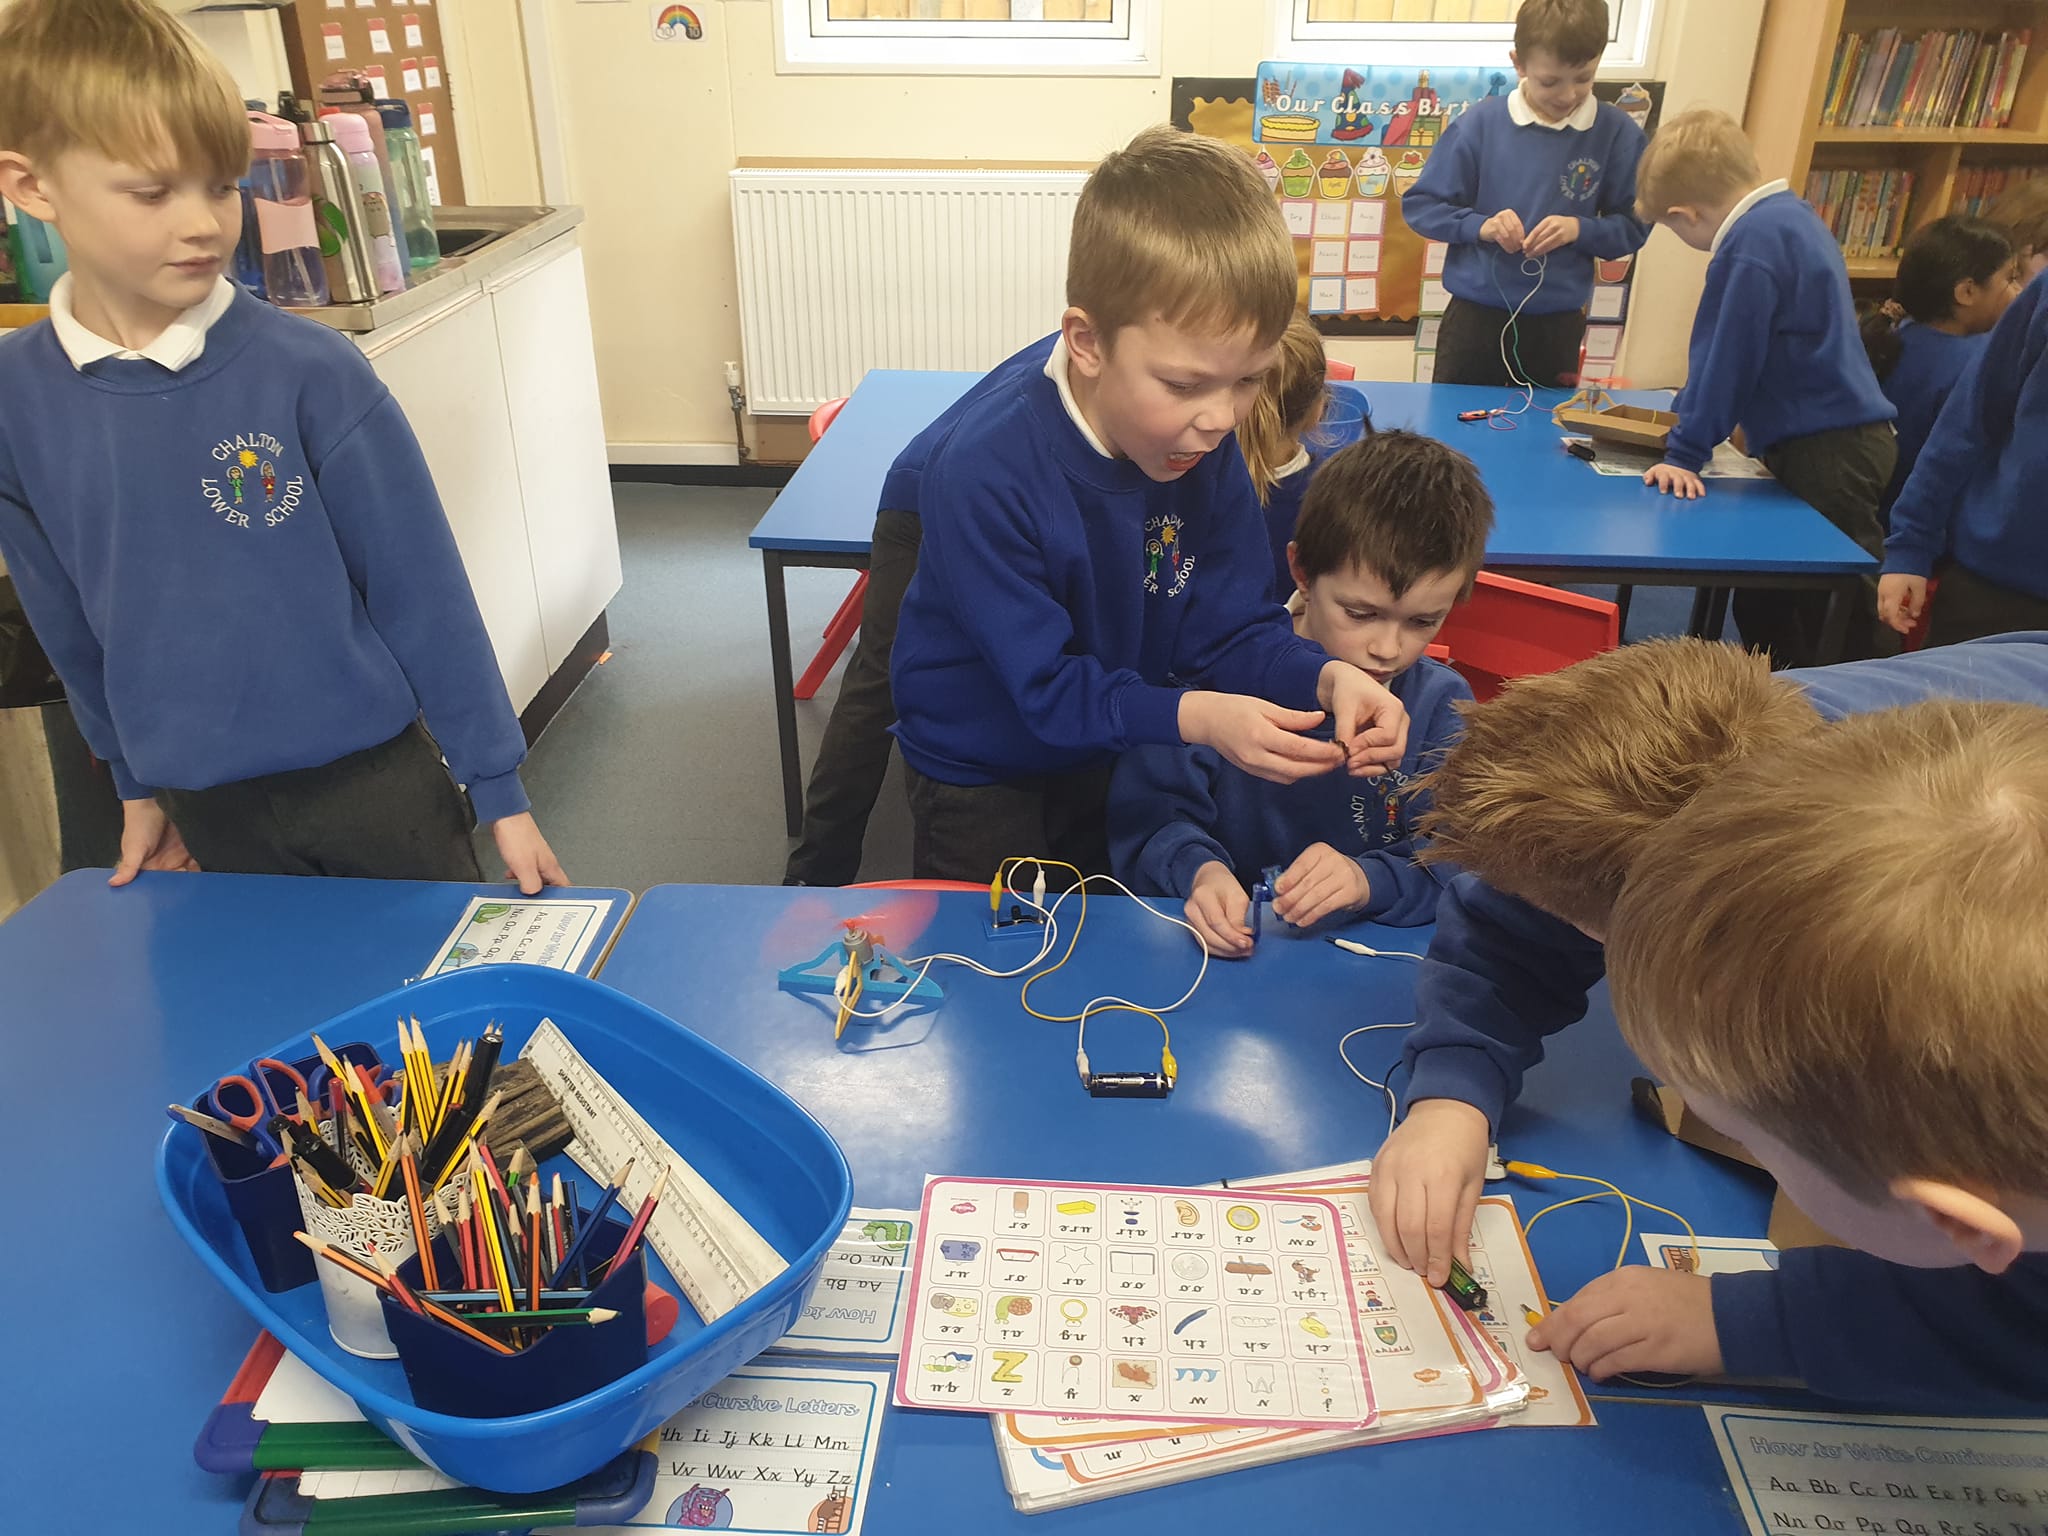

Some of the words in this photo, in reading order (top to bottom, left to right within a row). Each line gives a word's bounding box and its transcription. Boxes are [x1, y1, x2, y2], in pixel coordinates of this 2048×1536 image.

[1276, 95, 1326, 114] Our
[1331, 95, 1412, 116] Class
[1417, 96, 1473, 117] Birt
[211, 432, 284, 461] CHALTON
[201, 478, 249, 528] LOWER
[264, 475, 304, 527] SCHOOL
[558, 1068, 577, 1093] SHATTER
[574, 1090, 598, 1119] RESISTANT
[838, 1253, 862, 1265] Oo
[871, 1255, 894, 1266] Nn
[824, 1278, 848, 1290] Bb
[857, 1280, 882, 1292] Aa
[825, 1307, 877, 1324] How
[1002, 1388, 1014, 1396] z
[1064, 1388, 1078, 1399] y
[1128, 1394, 1143, 1402] x
[703, 1392, 783, 1413] Cursive
[785, 1396, 860, 1417] Letters
[692, 1428, 711, 1443] Ii
[719, 1430, 740, 1449] Jj
[750, 1432, 775, 1447] Kk
[784, 1434, 805, 1448] Ll
[814, 1435, 850, 1450] Mm
[1749, 1436, 1810, 1457] How
[1813, 1442, 1842, 1459] to
[672, 1461, 698, 1477] Vv
[707, 1463, 746, 1479] Ww
[753, 1466, 783, 1482] Xx
[793, 1468, 818, 1487] Yy
[827, 1470, 852, 1485] Zz
[1770, 1476, 1800, 1492] Aa
[1808, 1479, 1840, 1495] Bb
[1849, 1481, 1879, 1496] Cc
[1885, 1483, 1918, 1498] Dd
[1927, 1485, 1954, 1500] Ee
[1773, 1512, 1806, 1528] Nn
[1815, 1515, 1847, 1531] Oo
[1856, 1517, 1887, 1536] Pp
